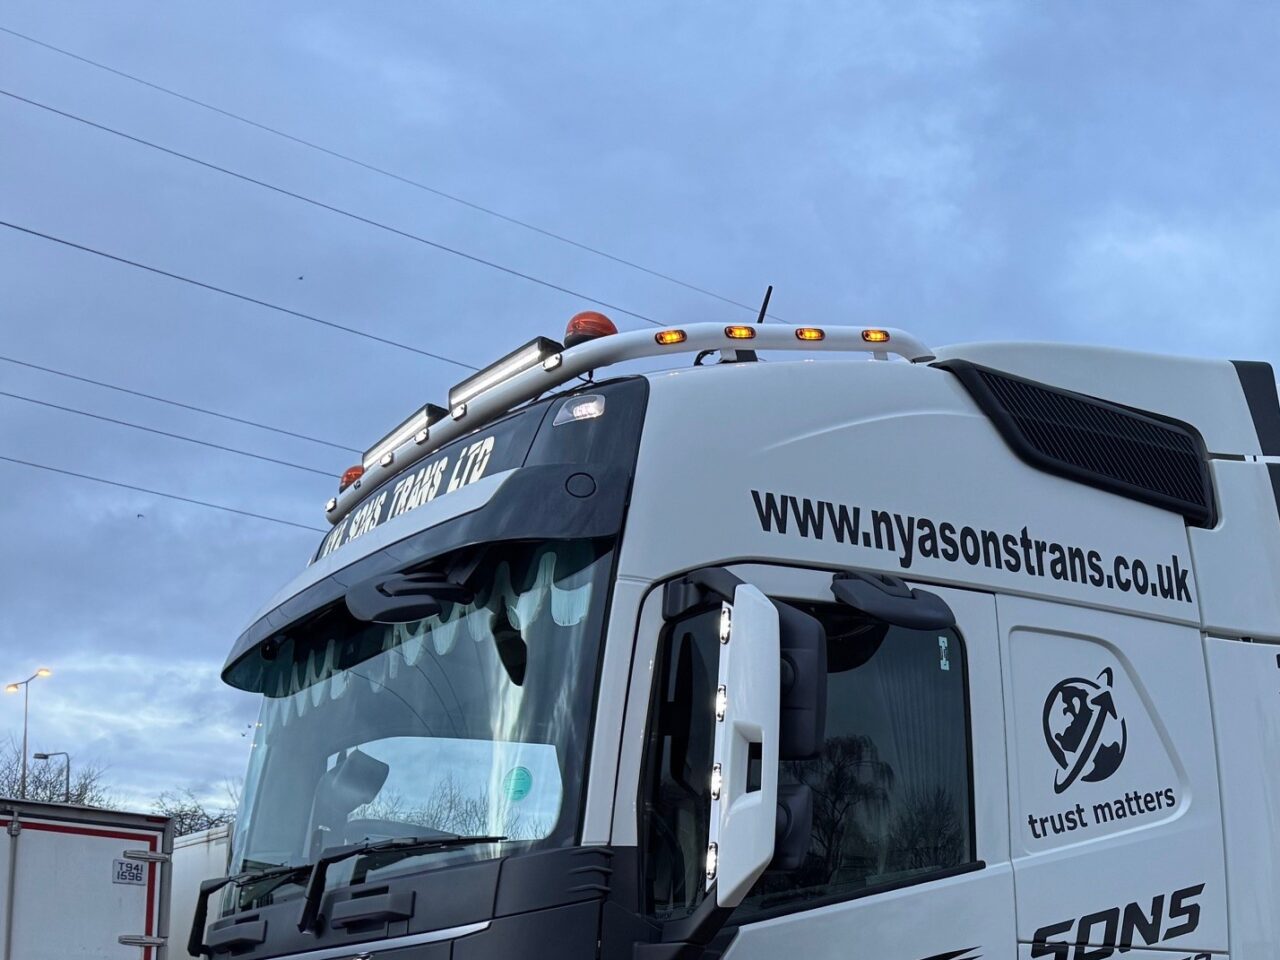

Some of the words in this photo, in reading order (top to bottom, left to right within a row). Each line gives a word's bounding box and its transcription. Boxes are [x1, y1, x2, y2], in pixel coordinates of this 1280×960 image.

[345, 491, 387, 544] SONS
[387, 456, 449, 522] TRANS
[446, 436, 495, 494] LTD
[750, 489, 1193, 603] www.nyasonstrans.co.uk
[1028, 803, 1088, 839] trust
[1092, 787, 1176, 824] matters
